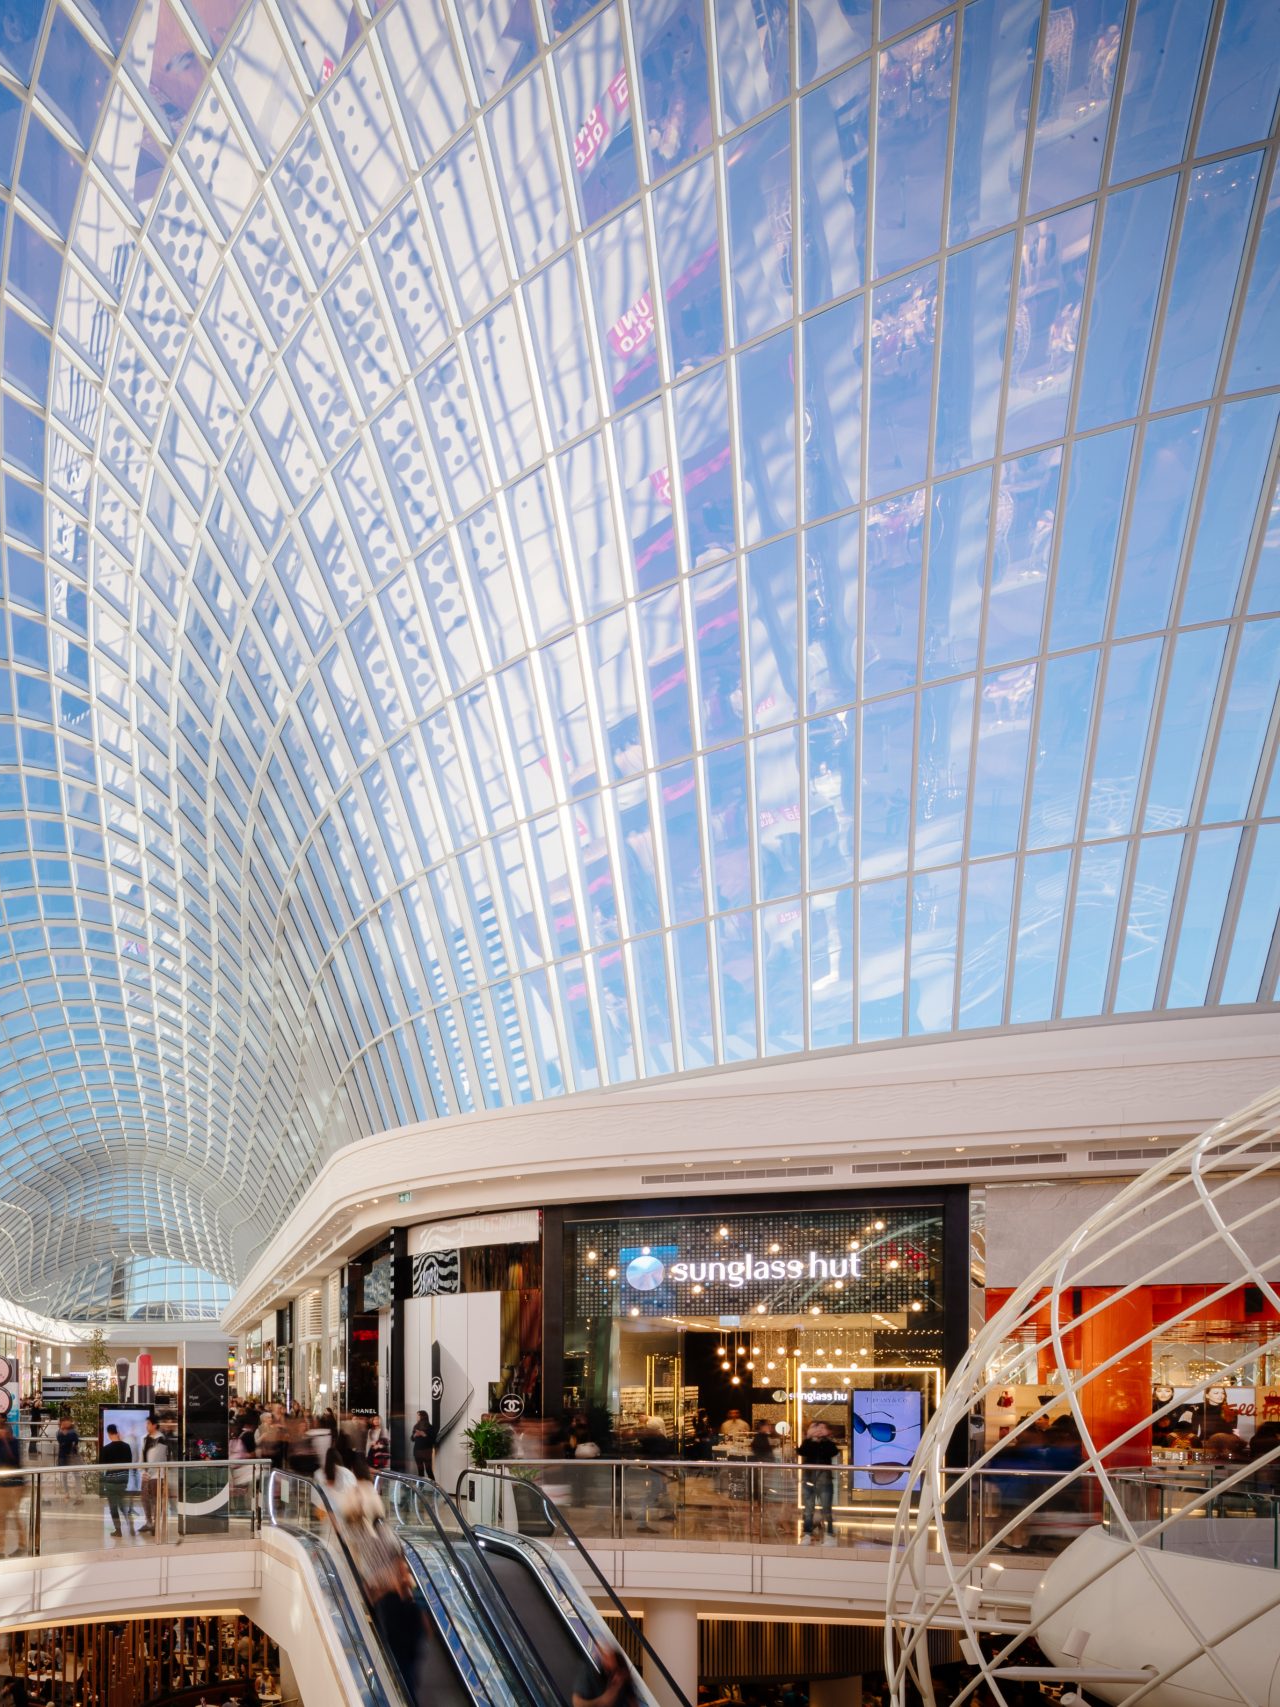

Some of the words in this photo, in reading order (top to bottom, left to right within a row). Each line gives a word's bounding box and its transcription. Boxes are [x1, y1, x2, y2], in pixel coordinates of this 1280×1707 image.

[671, 1253, 803, 1288] sunglass
[809, 1251, 861, 1279] hut
[214, 1373, 225, 1386] G
[789, 1390, 833, 1403] snglass
